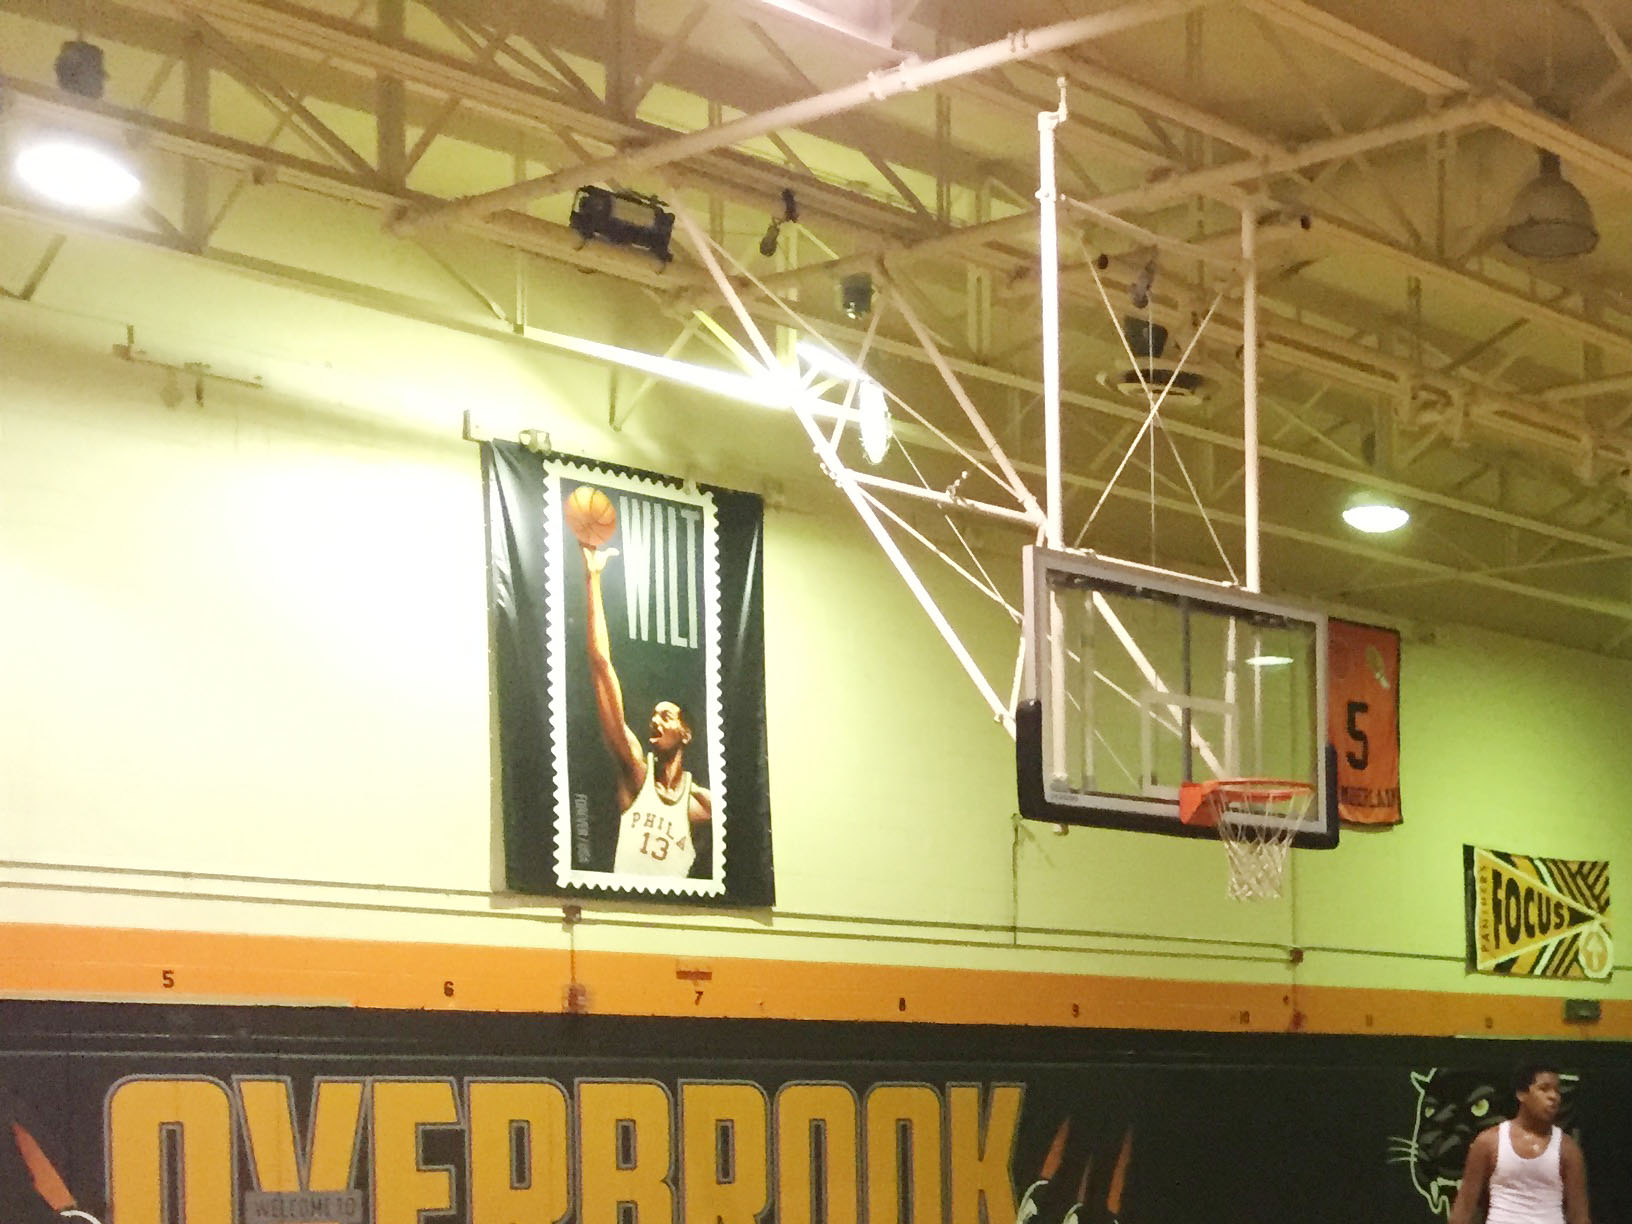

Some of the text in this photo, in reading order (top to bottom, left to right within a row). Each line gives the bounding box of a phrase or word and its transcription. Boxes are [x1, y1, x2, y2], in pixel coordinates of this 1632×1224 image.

[619, 495, 700, 649] WILT
[1346, 702, 1368, 770] 5
[631, 812, 686, 851] PHILA
[640, 832, 669, 860] 13
[1492, 868, 1565, 950] FOCUS
[163, 970, 174, 988] 5
[444, 981, 454, 997] 6
[694, 989, 704, 1002] 7
